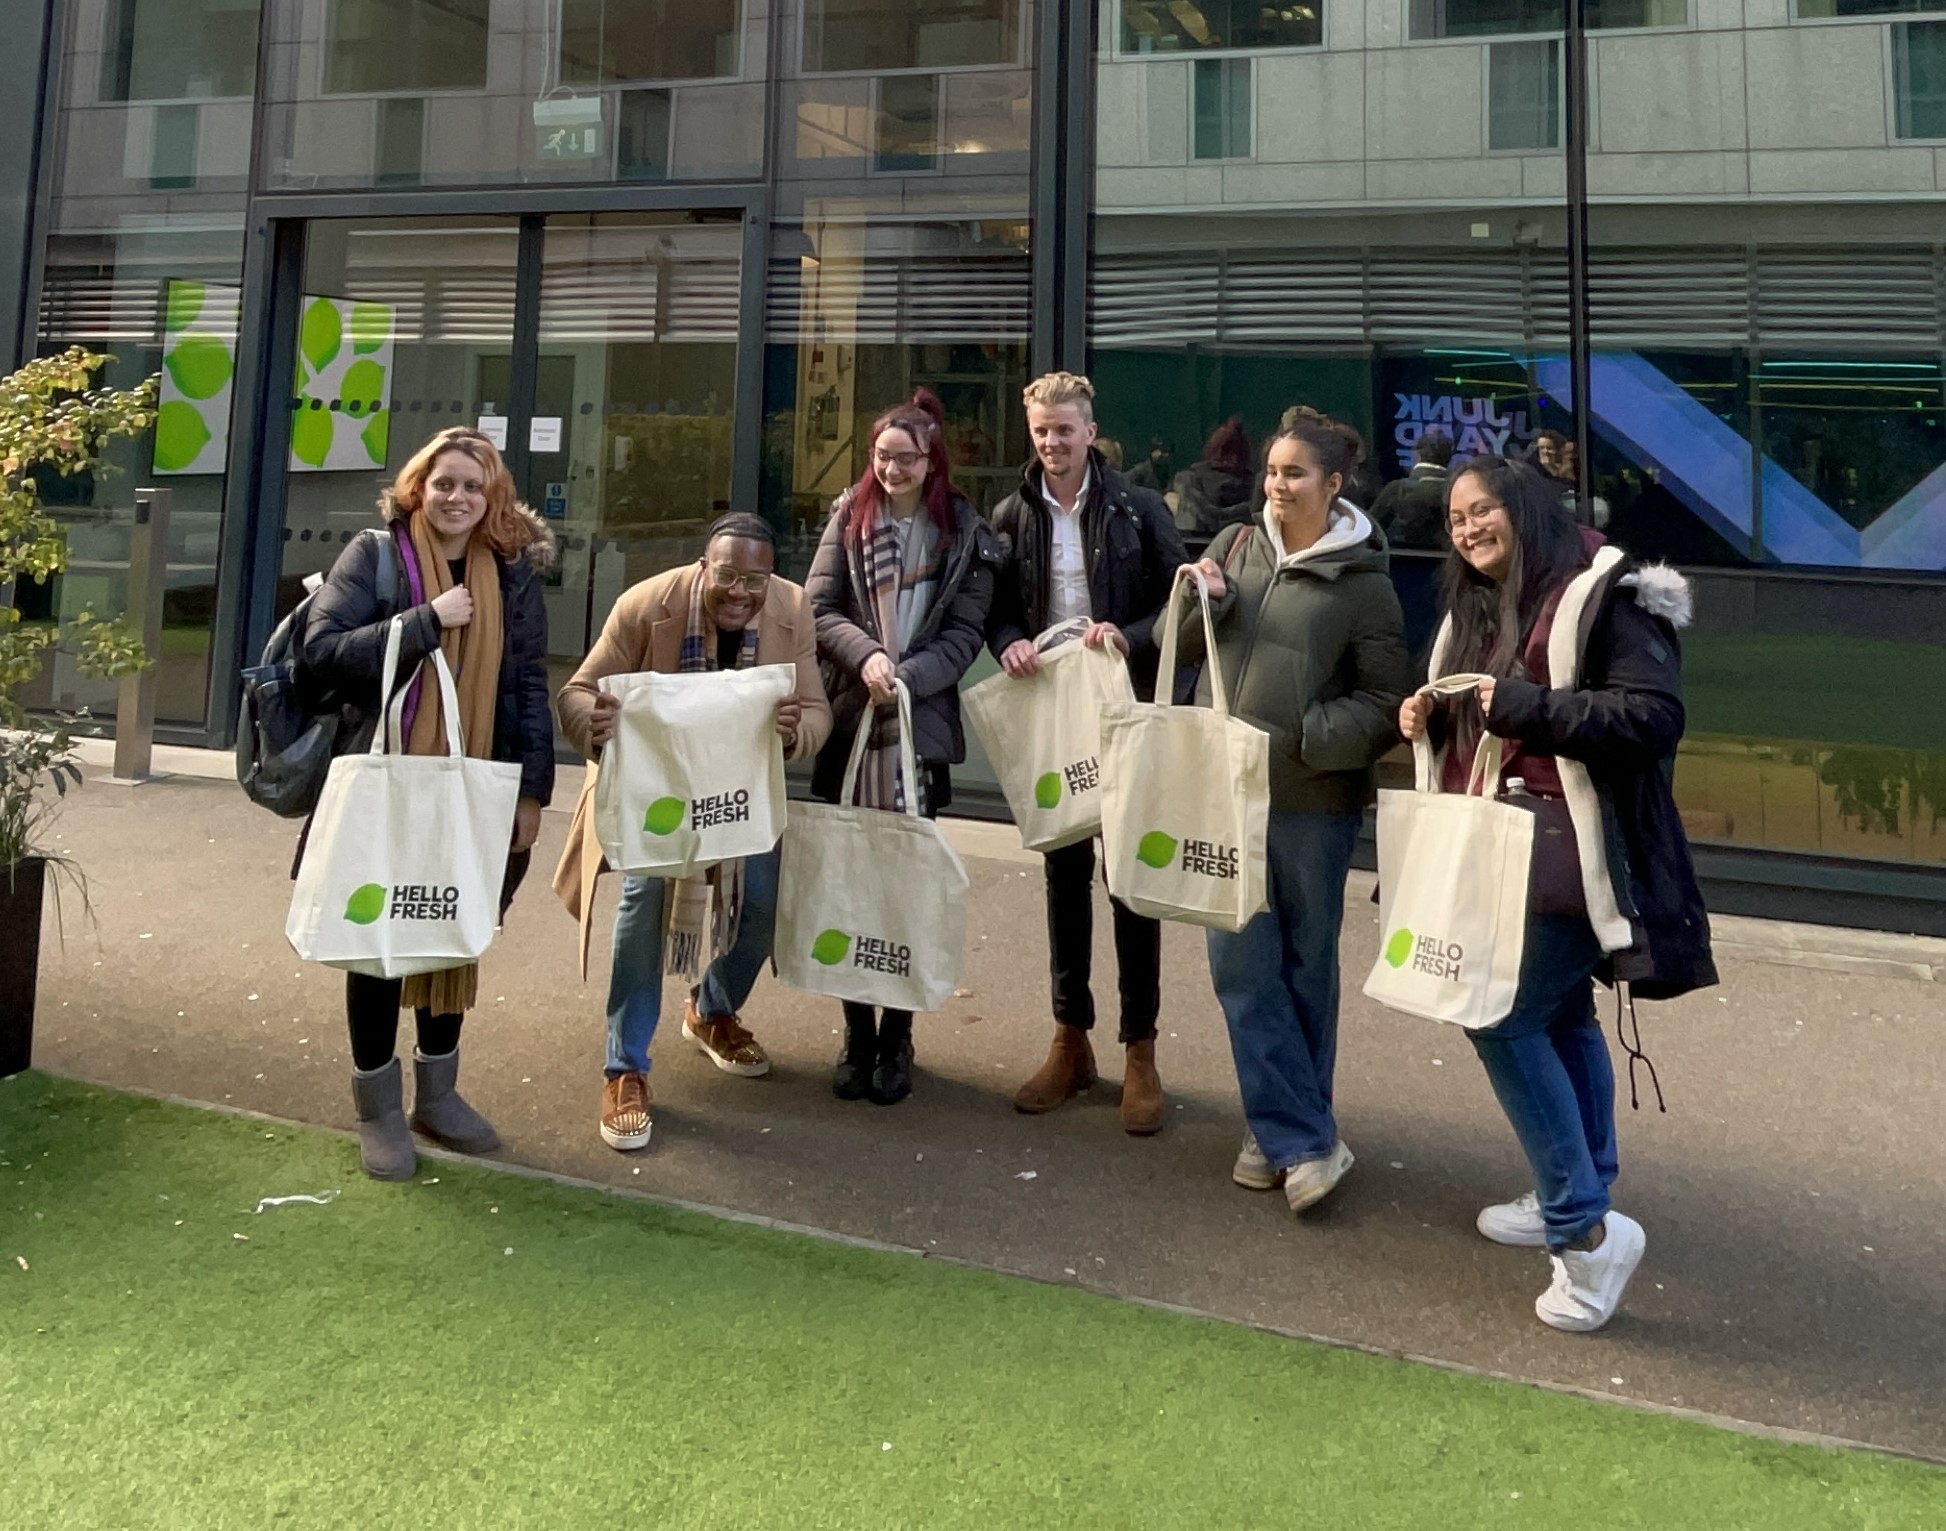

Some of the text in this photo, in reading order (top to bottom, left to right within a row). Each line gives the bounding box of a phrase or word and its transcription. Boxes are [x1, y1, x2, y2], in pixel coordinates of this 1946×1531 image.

[1064, 756, 1099, 781] HELL
[1069, 770, 1099, 796] FRE
[691, 789, 749, 814] HELLO
[691, 805, 749, 831] FRESH
[392, 885, 460, 903] HELLO
[389, 903, 458, 920] FRESH
[856, 935, 911, 961] HELLO
[1417, 934, 1464, 961] HELLO
[853, 952, 910, 977] FRESH
[1412, 953, 1461, 982] FRESH
